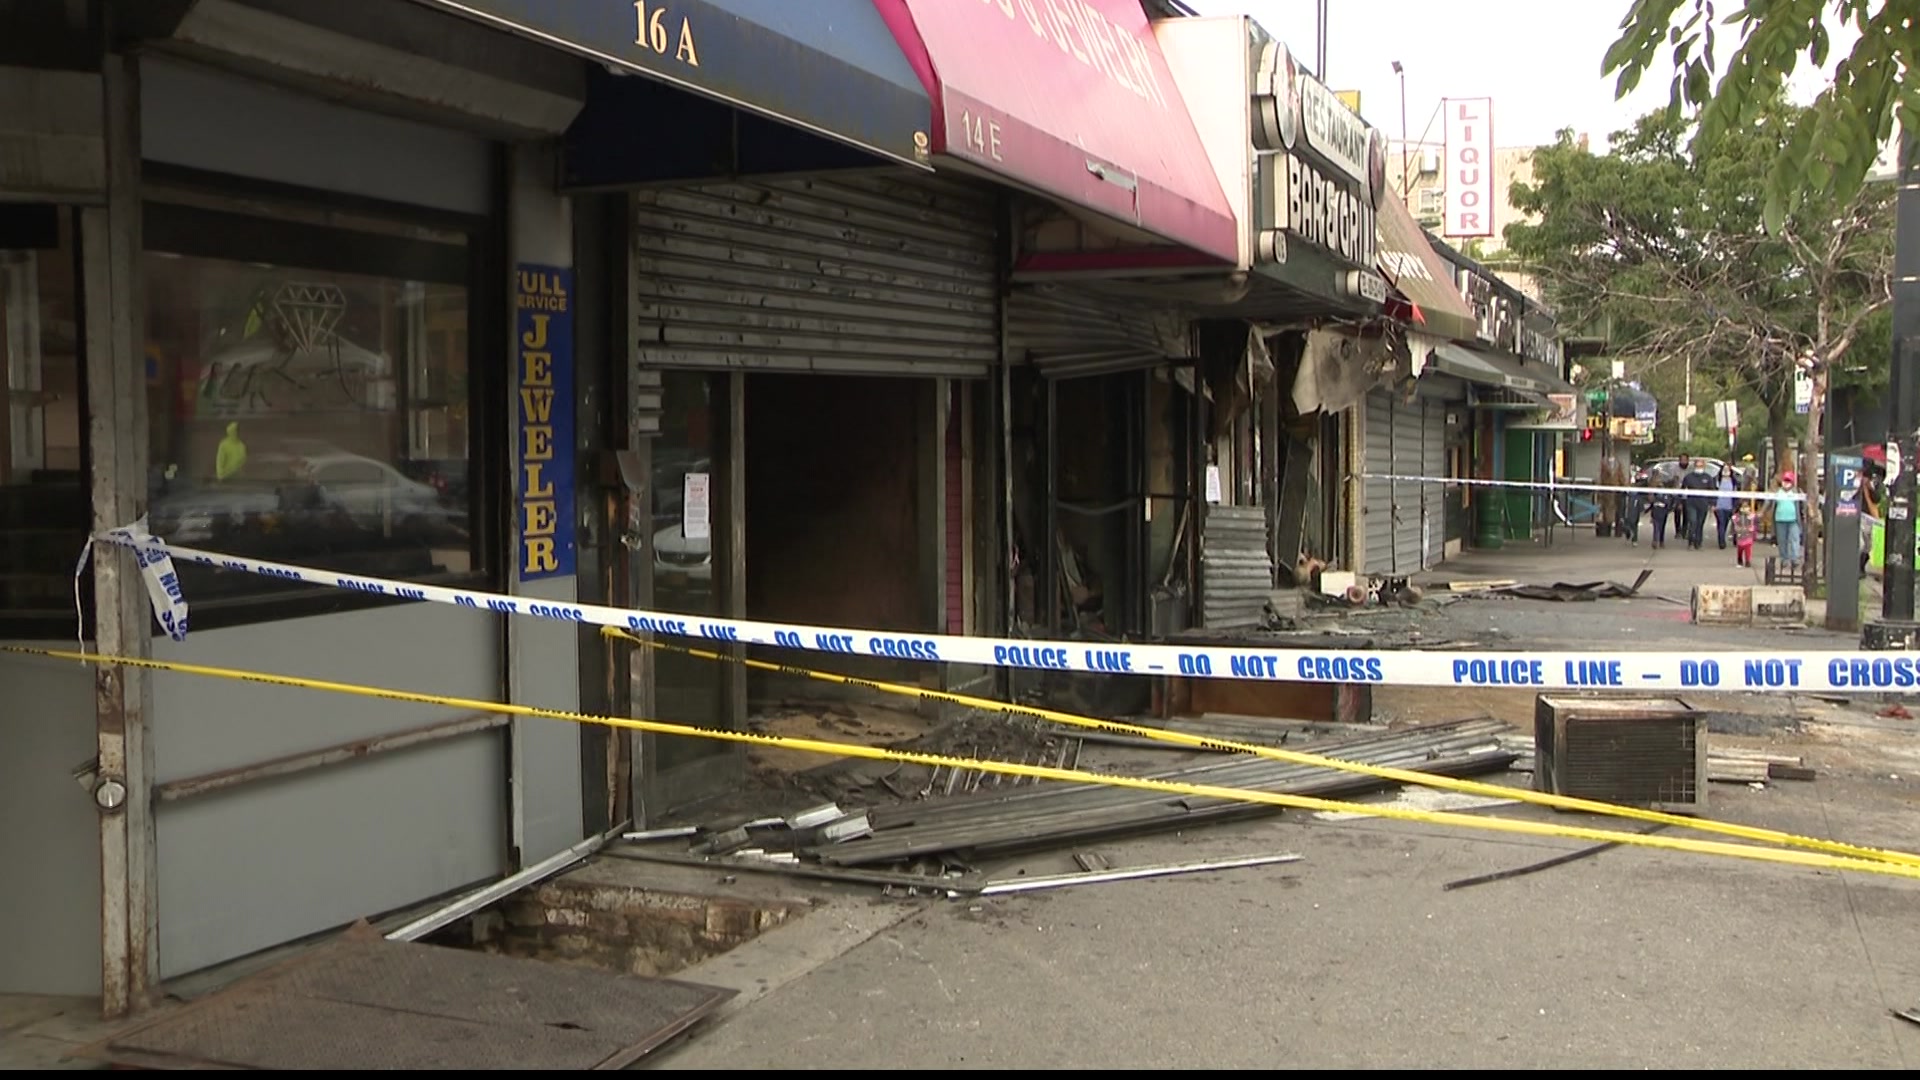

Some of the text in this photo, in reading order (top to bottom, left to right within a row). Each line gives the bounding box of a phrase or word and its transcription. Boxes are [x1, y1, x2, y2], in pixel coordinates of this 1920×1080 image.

[633, 0, 699, 68] 16 A
[962, 110, 1003, 163] 14 E
[1304, 85, 1366, 171] RESTAURANT
[1459, 103, 1480, 230] LIQUOR
[520, 314, 558, 573] JEWELER
[1843, 469, 1856, 486] P
[869, 637, 940, 661] CROSS
[994, 645, 1070, 669] POLICE
[1085, 650, 1133, 672] LINE
[1178, 654, 1213, 676] DO
[1230, 655, 1279, 678] NOT
[1297, 656, 1384, 682] CROSS
[1453, 659, 1545, 686] POLICE
[1565, 660, 1622, 687] LINE
[1680, 659, 1721, 687] DO
[1744, 659, 1802, 687] NOT
[1828, 658, 1920, 688] CROS
